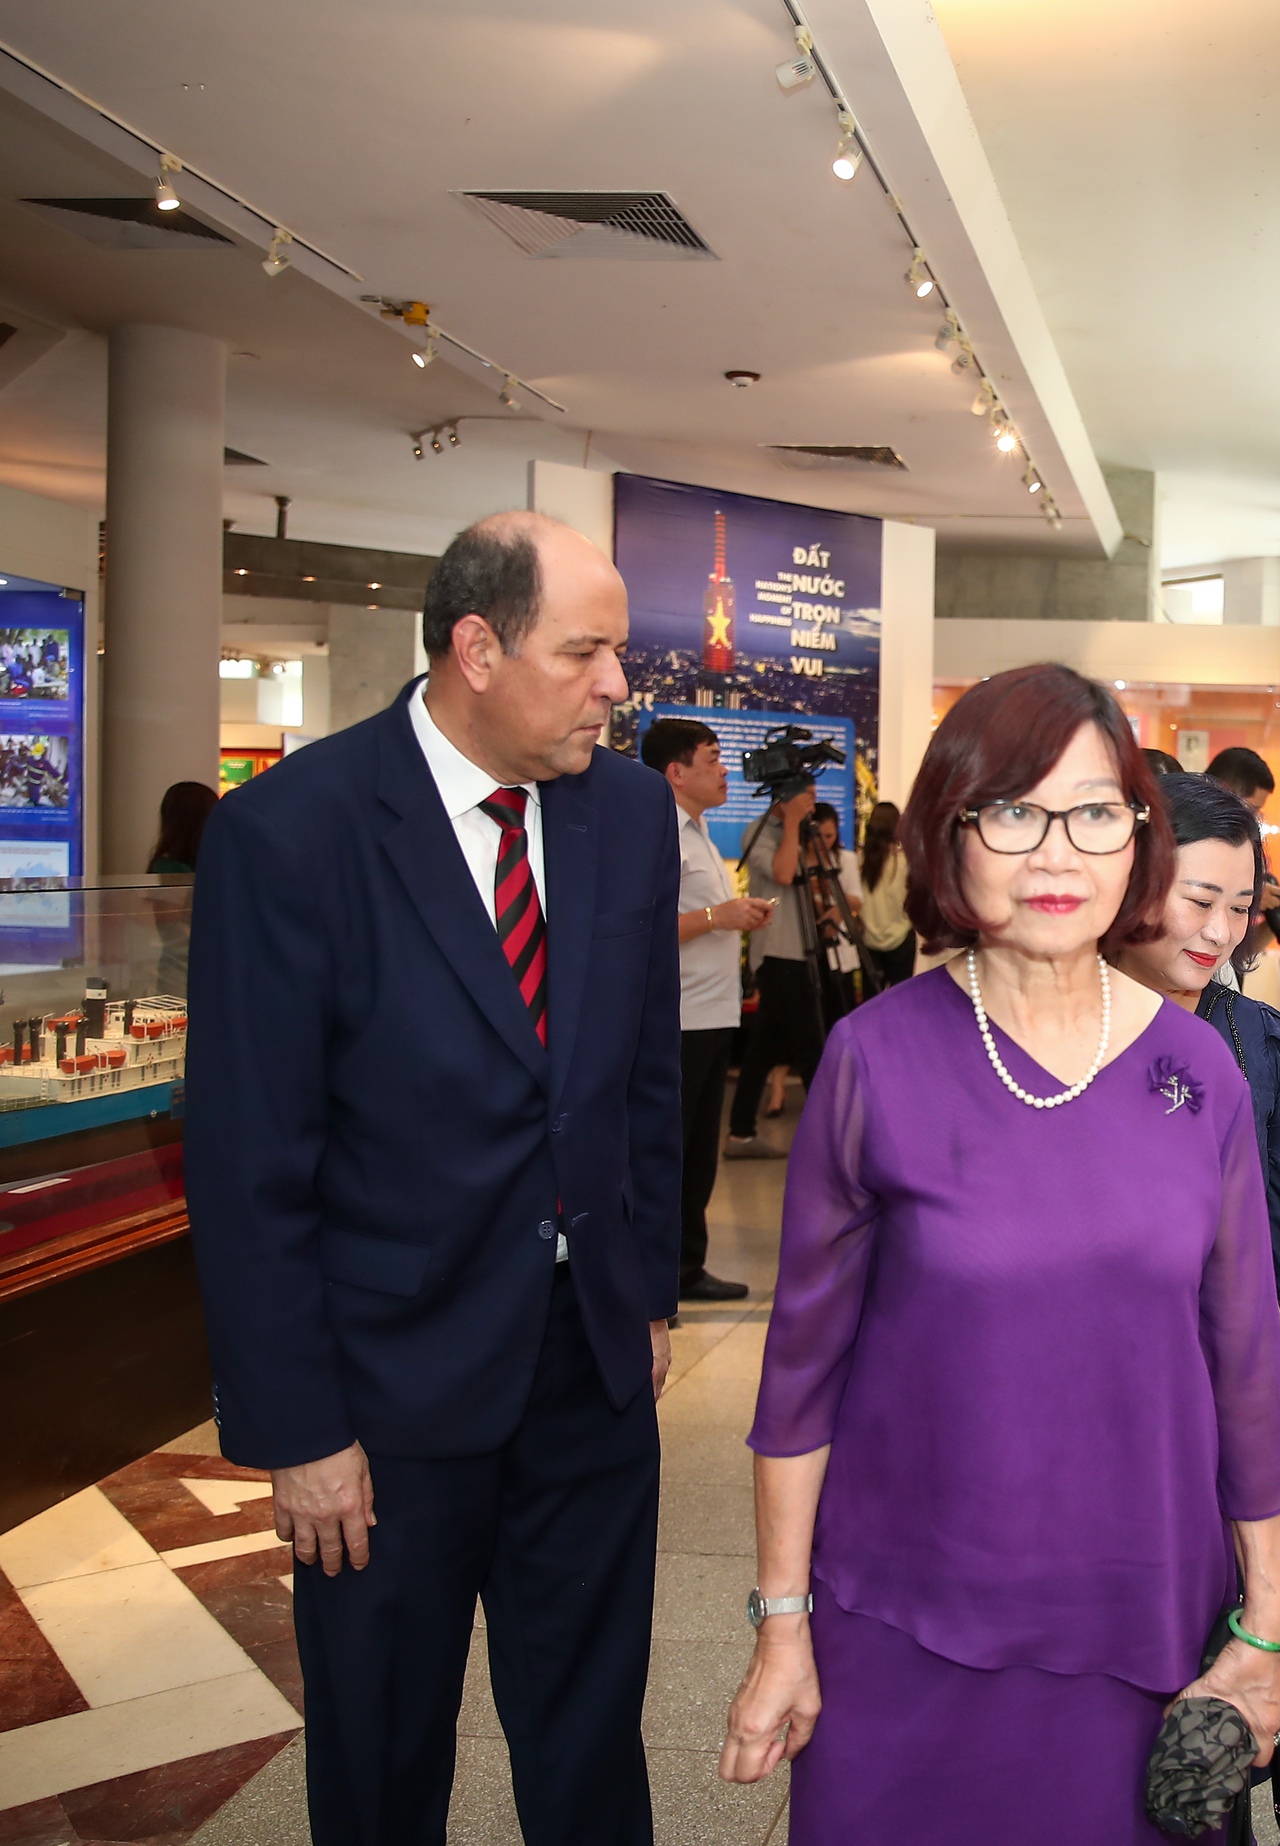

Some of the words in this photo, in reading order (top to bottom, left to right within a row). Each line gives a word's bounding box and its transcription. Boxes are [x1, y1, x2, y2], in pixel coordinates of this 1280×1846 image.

[792, 542, 831, 568] ĐẤT
[793, 574, 845, 598] NƯỚC
[790, 656, 824, 676] VUI
